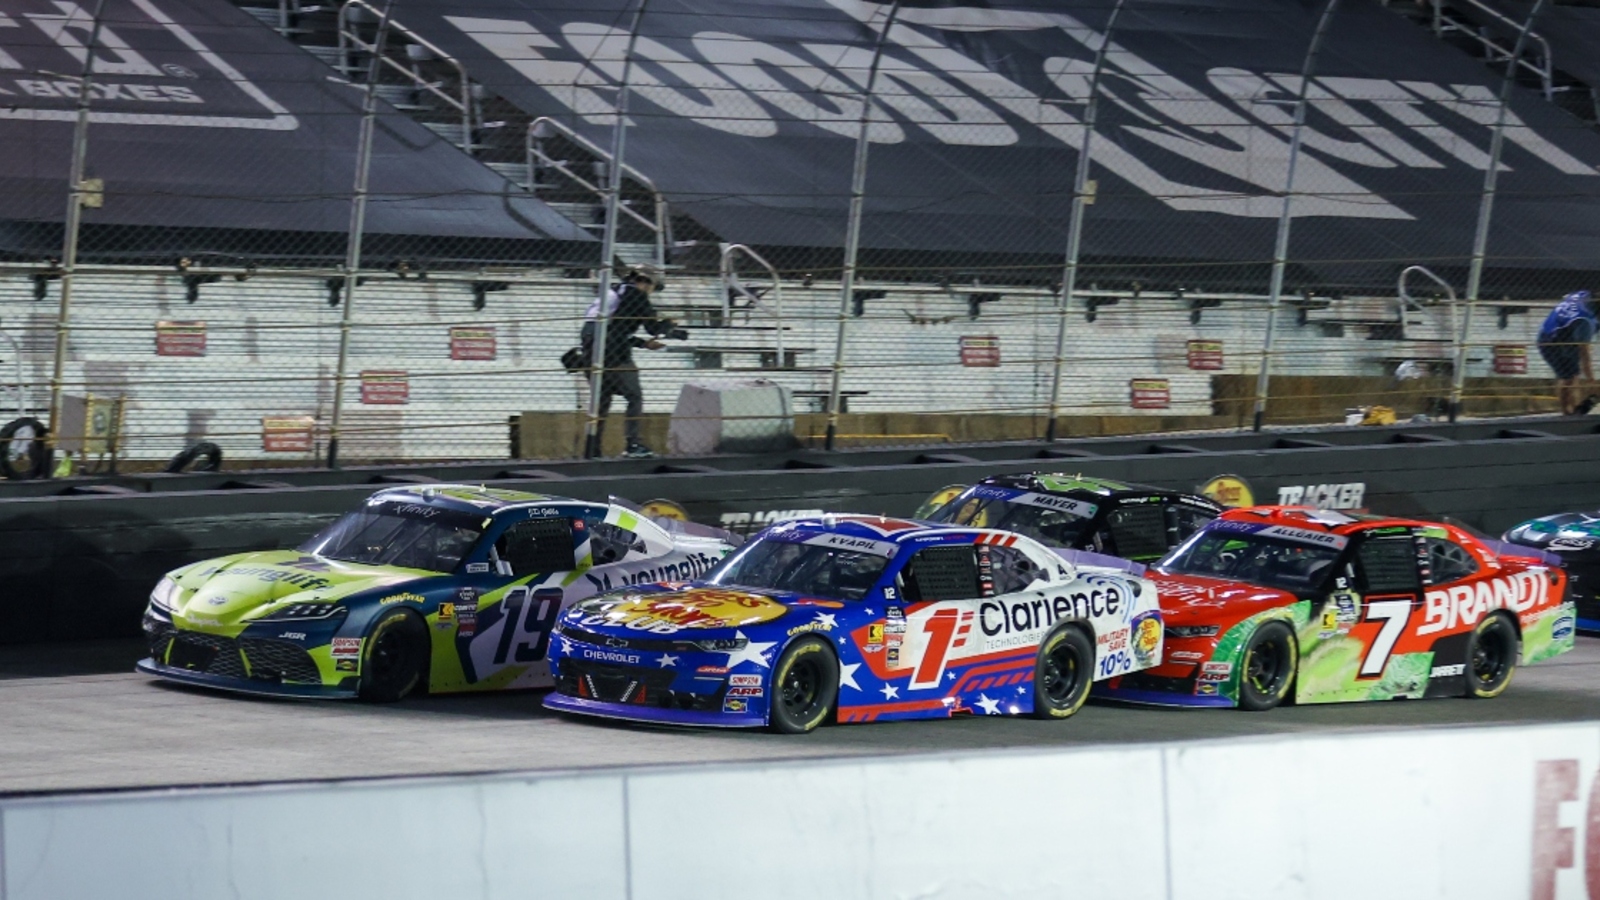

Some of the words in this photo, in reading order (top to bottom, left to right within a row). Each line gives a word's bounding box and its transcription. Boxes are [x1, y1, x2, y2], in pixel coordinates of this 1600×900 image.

[1033, 496, 1078, 511] MAYER
[1278, 482, 1366, 509] TRACKER
[828, 536, 877, 550] KVAPIL
[1272, 527, 1336, 544] ALLGAIER
[380, 592, 425, 605] GOODYEAR
[884, 587, 896, 600] 12
[980, 588, 1120, 636] Clarience
[493, 587, 564, 665] 19
[580, 615, 682, 635] CLUB
[1097, 627, 1130, 645] MILITARY
[1359, 598, 1412, 676] 7
[909, 608, 959, 690] 1
[1108, 638, 1127, 652] SAVE
[583, 649, 640, 664] CHEVROLET
[1100, 649, 1131, 677] 10%
[728, 687, 762, 695] ARP
